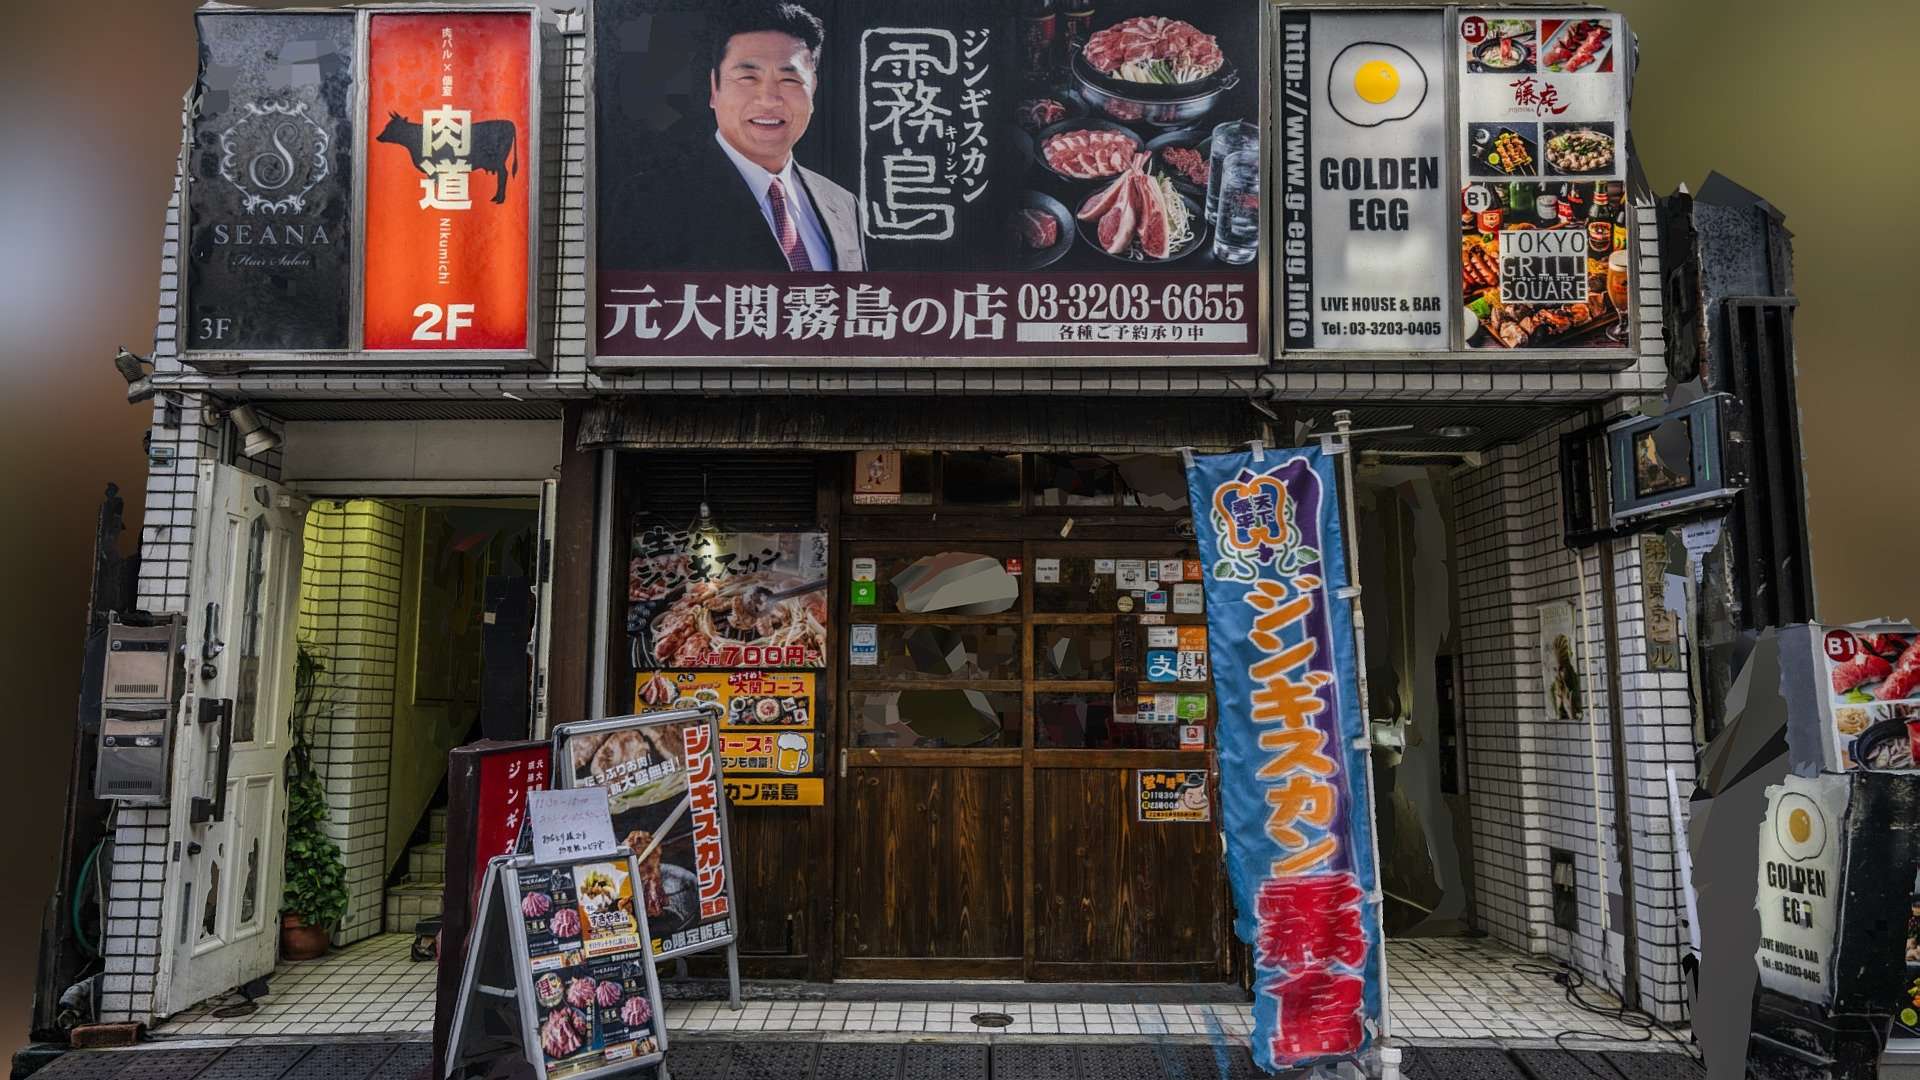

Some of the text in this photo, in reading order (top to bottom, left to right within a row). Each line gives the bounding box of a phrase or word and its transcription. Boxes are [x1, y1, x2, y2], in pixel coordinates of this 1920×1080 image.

[1464, 23, 1486, 37] B1
[959, 27, 991, 203] ジンギスカン
[419, 104, 473, 212] 肉道
[944, 125, 958, 185] キリシマ
[1285, 24, 1308, 337] http://www.g-egg.info
[1319, 156, 1440, 190] GOLDEN
[1467, 191, 1489, 207] B1
[1350, 198, 1410, 231] EGG
[213, 224, 330, 246] SEANA
[1502, 232, 1586, 253] TOKYO
[439, 217, 452, 285] Nikumichi
[1501, 256, 1586, 277] GRILL
[1501, 280, 1586, 300] SQUARE
[603, 284, 1008, 342] 元大関霧島の店
[1017, 283, 1245, 321] 03-3203-6655
[1321, 297, 1441, 312] LIVE HOUSE & BAR
[200, 318, 232, 340] 3F
[411, 303, 475, 342] 2F
[1058, 324, 1205, 342] 各種ご予約承り中
[1349, 322, 1442, 336] 03-3203-0405
[1827, 637, 1855, 656] B1
[734, 681, 805, 694] 大関コース
[1244, 574, 1339, 877] ジンギスカン
[683, 724, 729, 898] ジンギスカン
[1775, 940, 1798, 958] HOUSE
